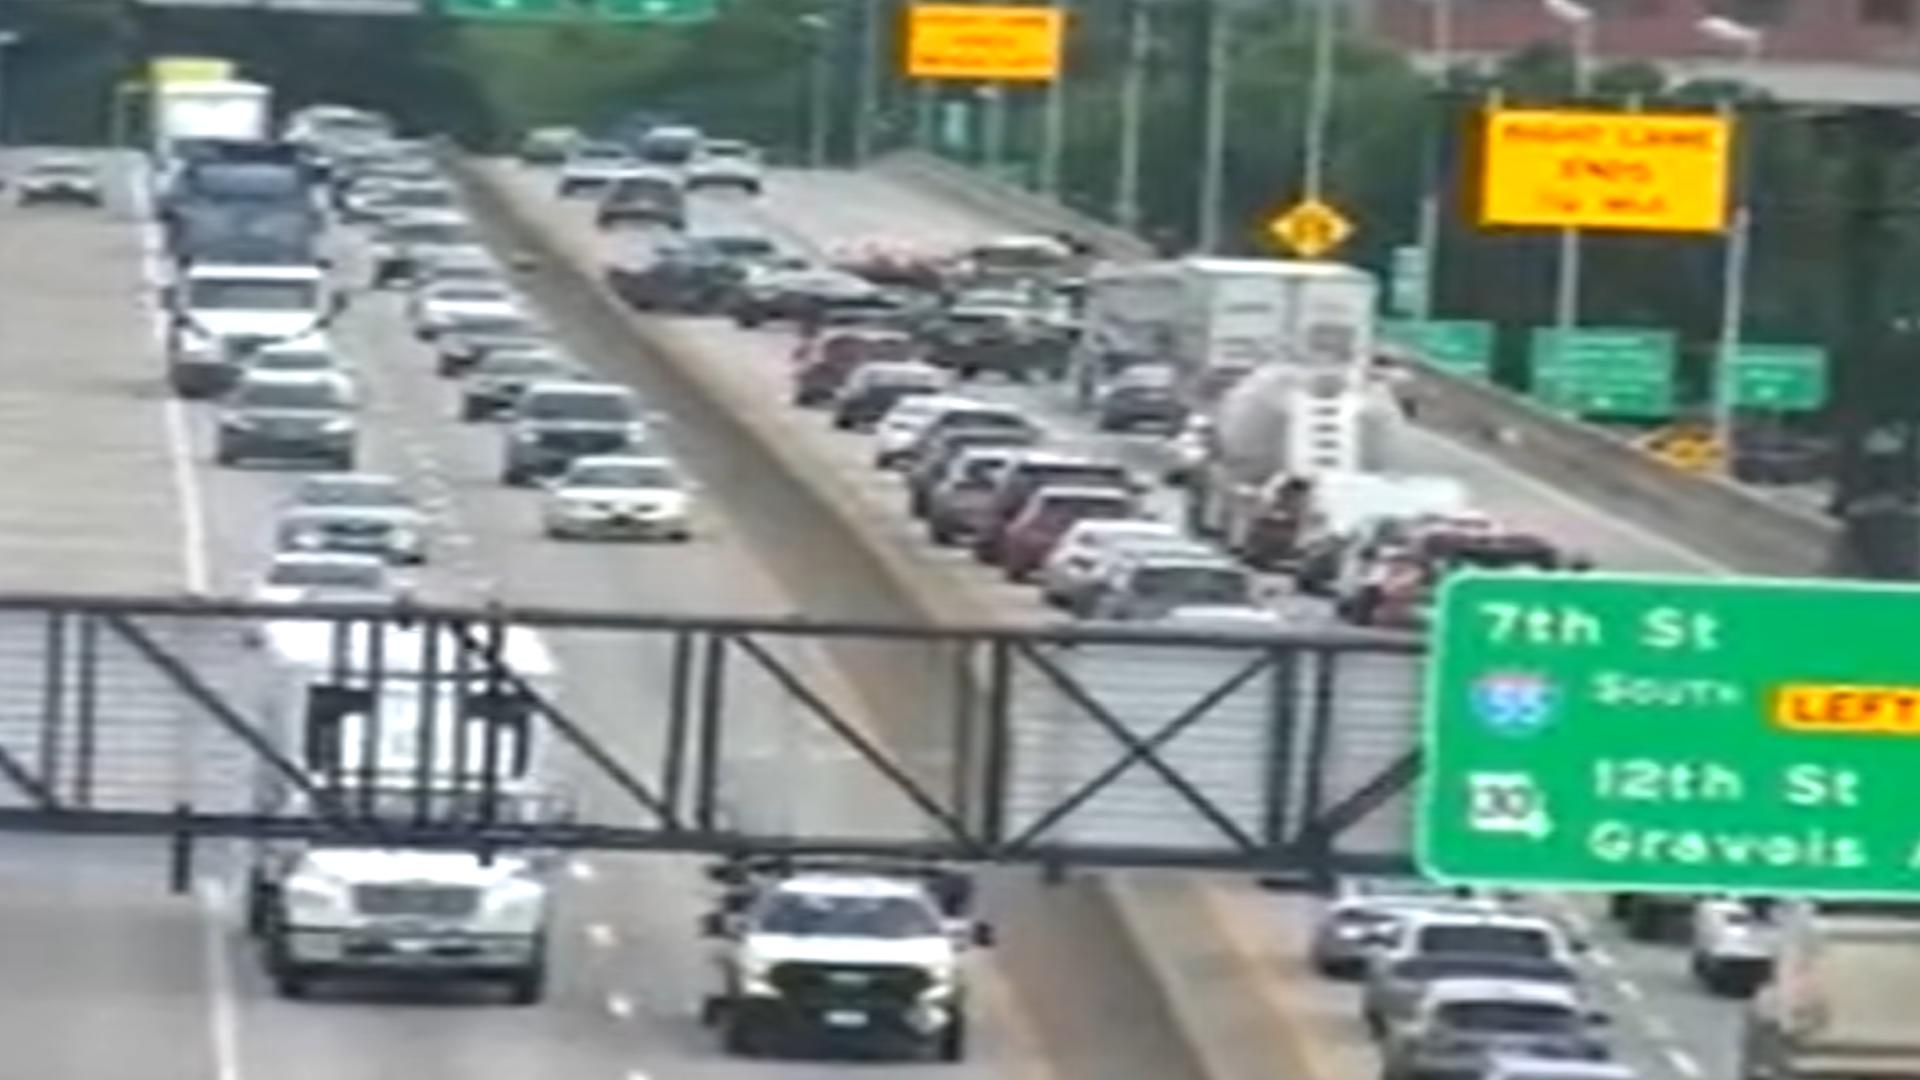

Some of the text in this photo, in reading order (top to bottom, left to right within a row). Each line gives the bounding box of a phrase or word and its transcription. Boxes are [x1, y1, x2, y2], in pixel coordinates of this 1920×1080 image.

[1480, 603, 1720, 650] 7th St
[1793, 692, 1920, 724] LEFT
[1594, 757, 1858, 806] 12th St
[1589, 821, 1865, 868] Gravois
